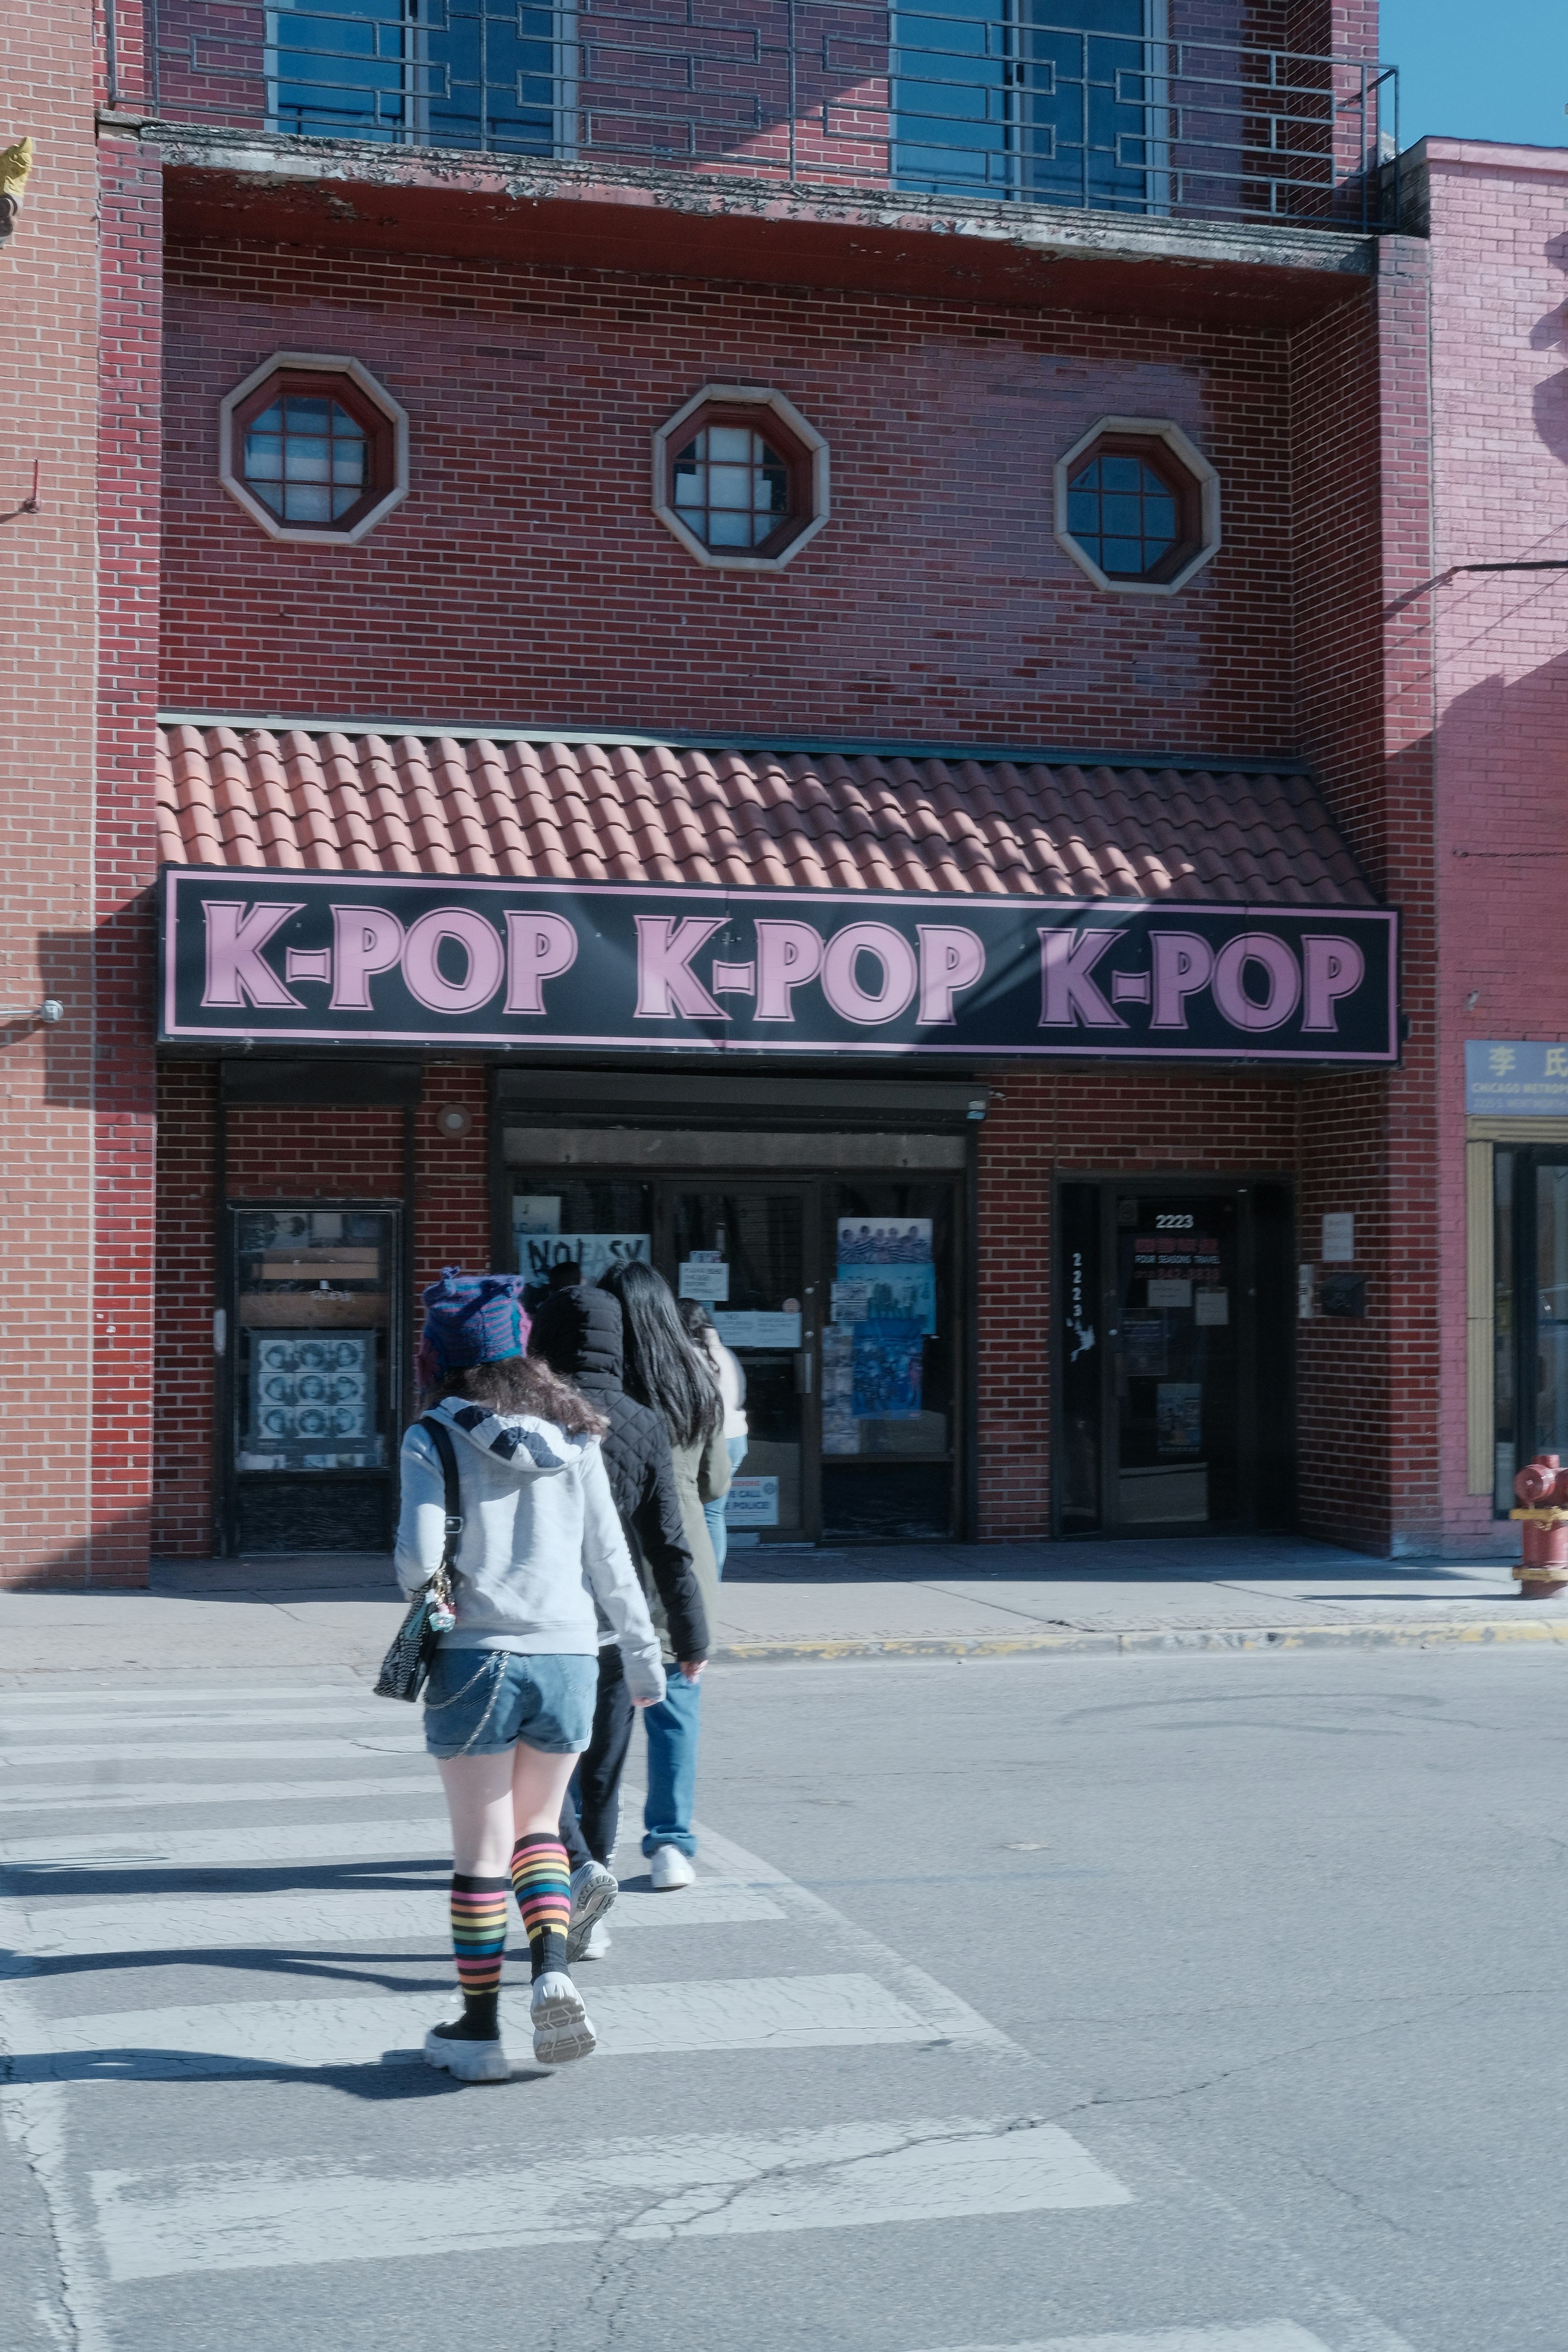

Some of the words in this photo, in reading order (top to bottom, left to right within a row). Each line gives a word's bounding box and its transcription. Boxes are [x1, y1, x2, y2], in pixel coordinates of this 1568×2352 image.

[200, 900, 578, 1014] K-POP
[633, 915, 986, 1026] K-POP
[1037, 927, 1365, 1033] K-POP
[1472, 1083, 1521, 1093] CHICAGO
[1155, 1214, 1194, 1229] 2223
[1135, 1255, 1156, 1263] FOUR
[1157, 1255, 1192, 1264] SEASONS
[1193, 1255, 1222, 1264] TRAVEL
[1072, 1253, 1083, 1317] 2223
